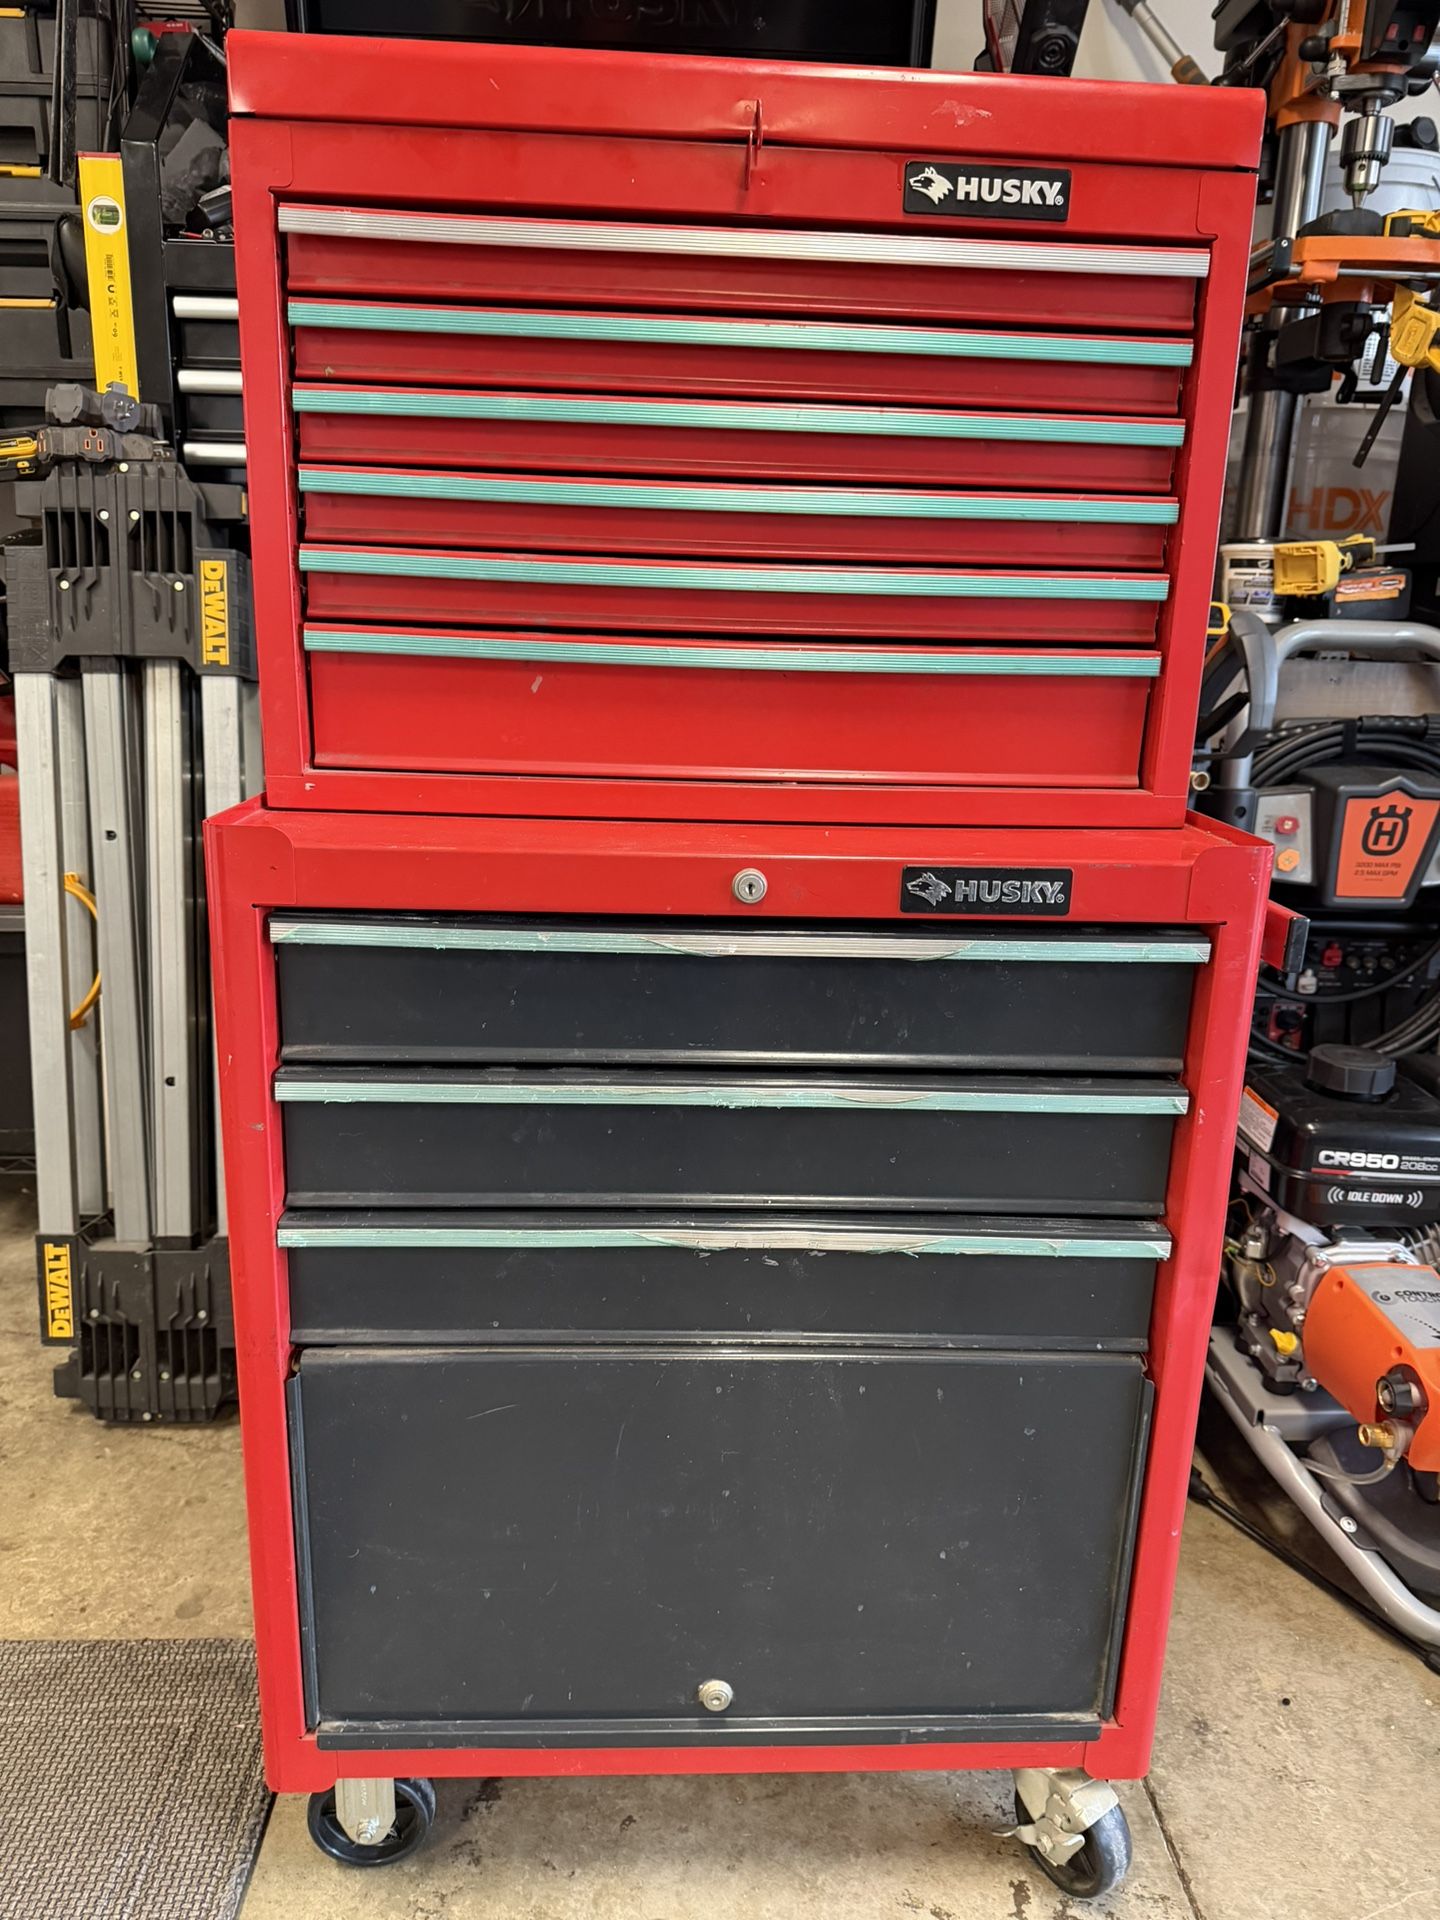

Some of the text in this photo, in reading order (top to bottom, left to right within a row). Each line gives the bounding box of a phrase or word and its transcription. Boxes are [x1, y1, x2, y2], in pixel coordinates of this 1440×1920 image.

[1287, 487, 1391, 532] HDX
[1318, 1150, 1399, 1170] CR950
[1400, 1161, 1438, 1171] 208cc
[1347, 1191, 1404, 1204] IDLE DOWN
